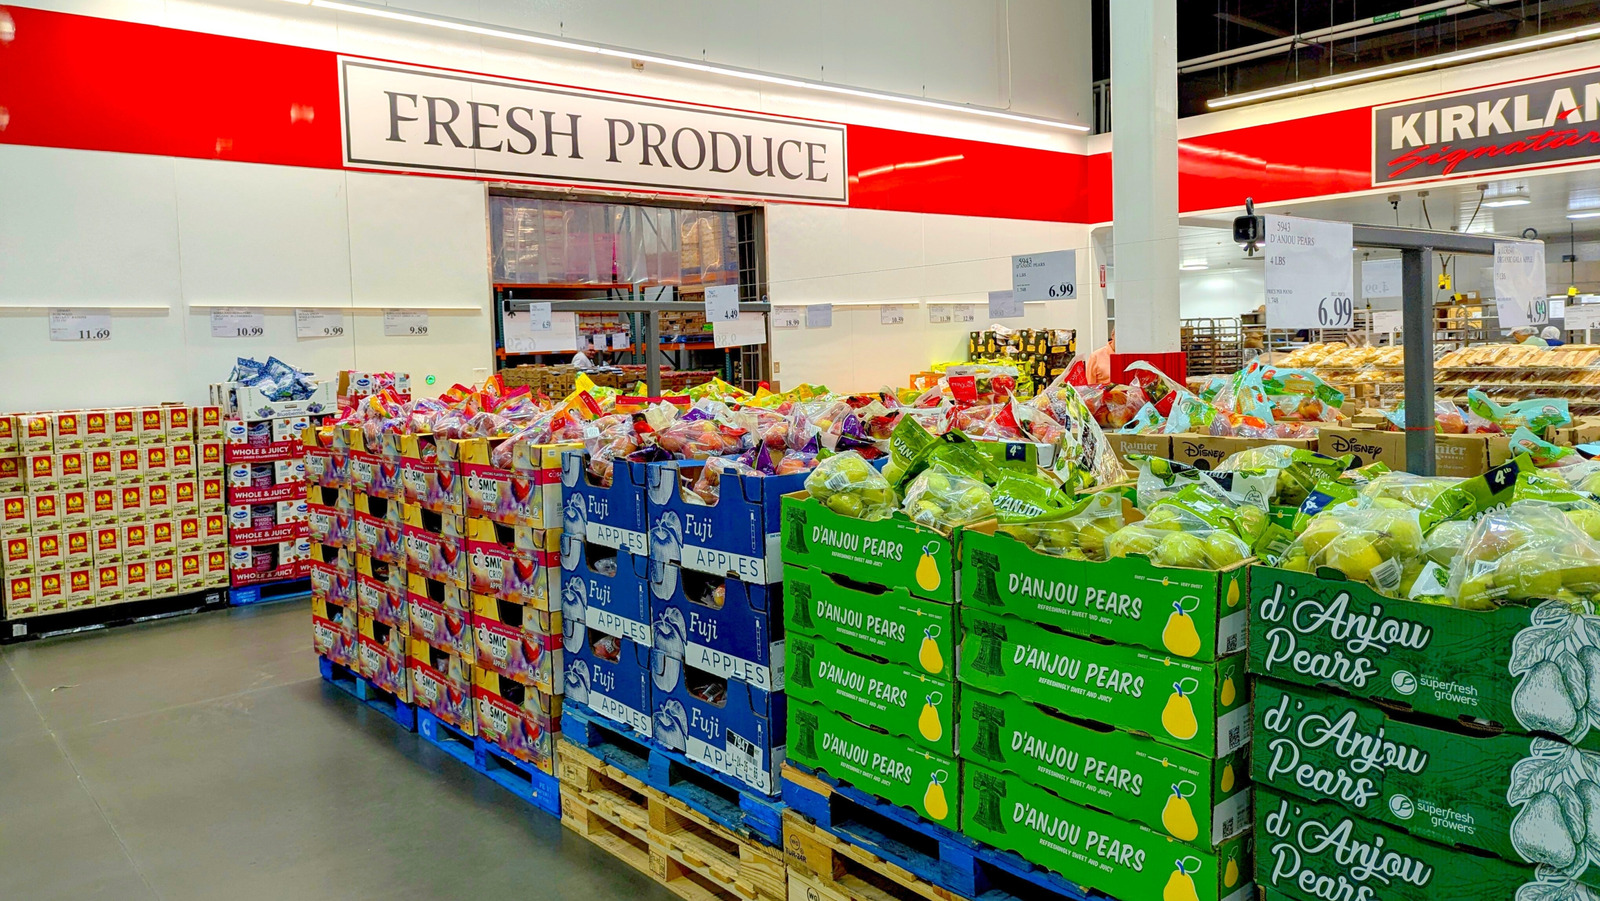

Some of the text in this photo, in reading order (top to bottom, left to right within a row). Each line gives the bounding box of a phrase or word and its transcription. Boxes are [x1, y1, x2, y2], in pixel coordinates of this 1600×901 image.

[384, 90, 830, 182] FRESH PRODUCE
[1270, 234, 1315, 247] D'ANJOU PEARS
[1277, 221, 1291, 233] 5943
[1275, 256, 1286, 266] LBS
[1048, 283, 1074, 297] 6.99
[724, 310, 738, 320] 4.49
[1318, 297, 1352, 326] 6.99
[1526, 300, 1547, 323] 4.99
[79, 329, 110, 340] 11.69
[237, 327, 263, 337] 10.99
[324, 327, 344, 337] 9.99
[409, 326, 428, 335] 9.89
[1120, 441, 1158, 452] Rainier
[270, 487, 291, 496] JUICY
[588, 495, 609, 520] Fuji
[235, 532, 263, 540] WHOLE
[271, 528, 292, 536] JUICY
[597, 522, 643, 550] APPLES
[685, 513, 713, 543] Fuji
[812, 525, 903, 561] D'ANJOU PEARS
[236, 572, 265, 581] WHOLE
[274, 568, 292, 577] JUICY
[696, 549, 759, 577] APPLES
[589, 580, 611, 606] Fuji
[1008, 572, 1142, 619] D'ANJOU PEARS
[597, 613, 646, 641] APPLES
[690, 611, 718, 642] Fuji
[817, 600, 906, 643] D'ANJOU PEARS
[1071, 609, 1087, 620] SWEET
[701, 649, 764, 684] APPLES
[1013, 644, 1144, 698] D'ANJOU PEARS
[1266, 628, 1377, 688] Pears
[592, 664, 615, 692] Fuji
[818, 661, 865, 692] D'ANJOU
[868, 678, 907, 708] PEARS
[1038, 676, 1070, 693] REFRESHINGLY
[1070, 685, 1087, 697] SWEET
[1087, 689, 1097, 698] AND
[1420, 676, 1478, 696] superfresh
[1434, 690, 1479, 707] growers
[601, 699, 647, 731] APPLES
[691, 707, 720, 739] Fuji
[733, 734, 749, 753] 7947
[822, 733, 869, 767] D'ANJOU
[872, 753, 912, 784] PEARS
[1011, 731, 1143, 797] D'ANJOU PEARS
[1037, 765, 1070, 783] REFRESHINGLY
[1086, 782, 1097, 793] AND
[1098, 786, 1113, 798] JUICY
[1268, 739, 1378, 807] Pears
[1417, 801, 1475, 825] superfresh
[1430, 815, 1476, 835] growers
[1012, 802, 1146, 872] D'ANJOU PEARS
[1039, 838, 1114, 874] REFRESHINGLY SWEET AND JUICY
